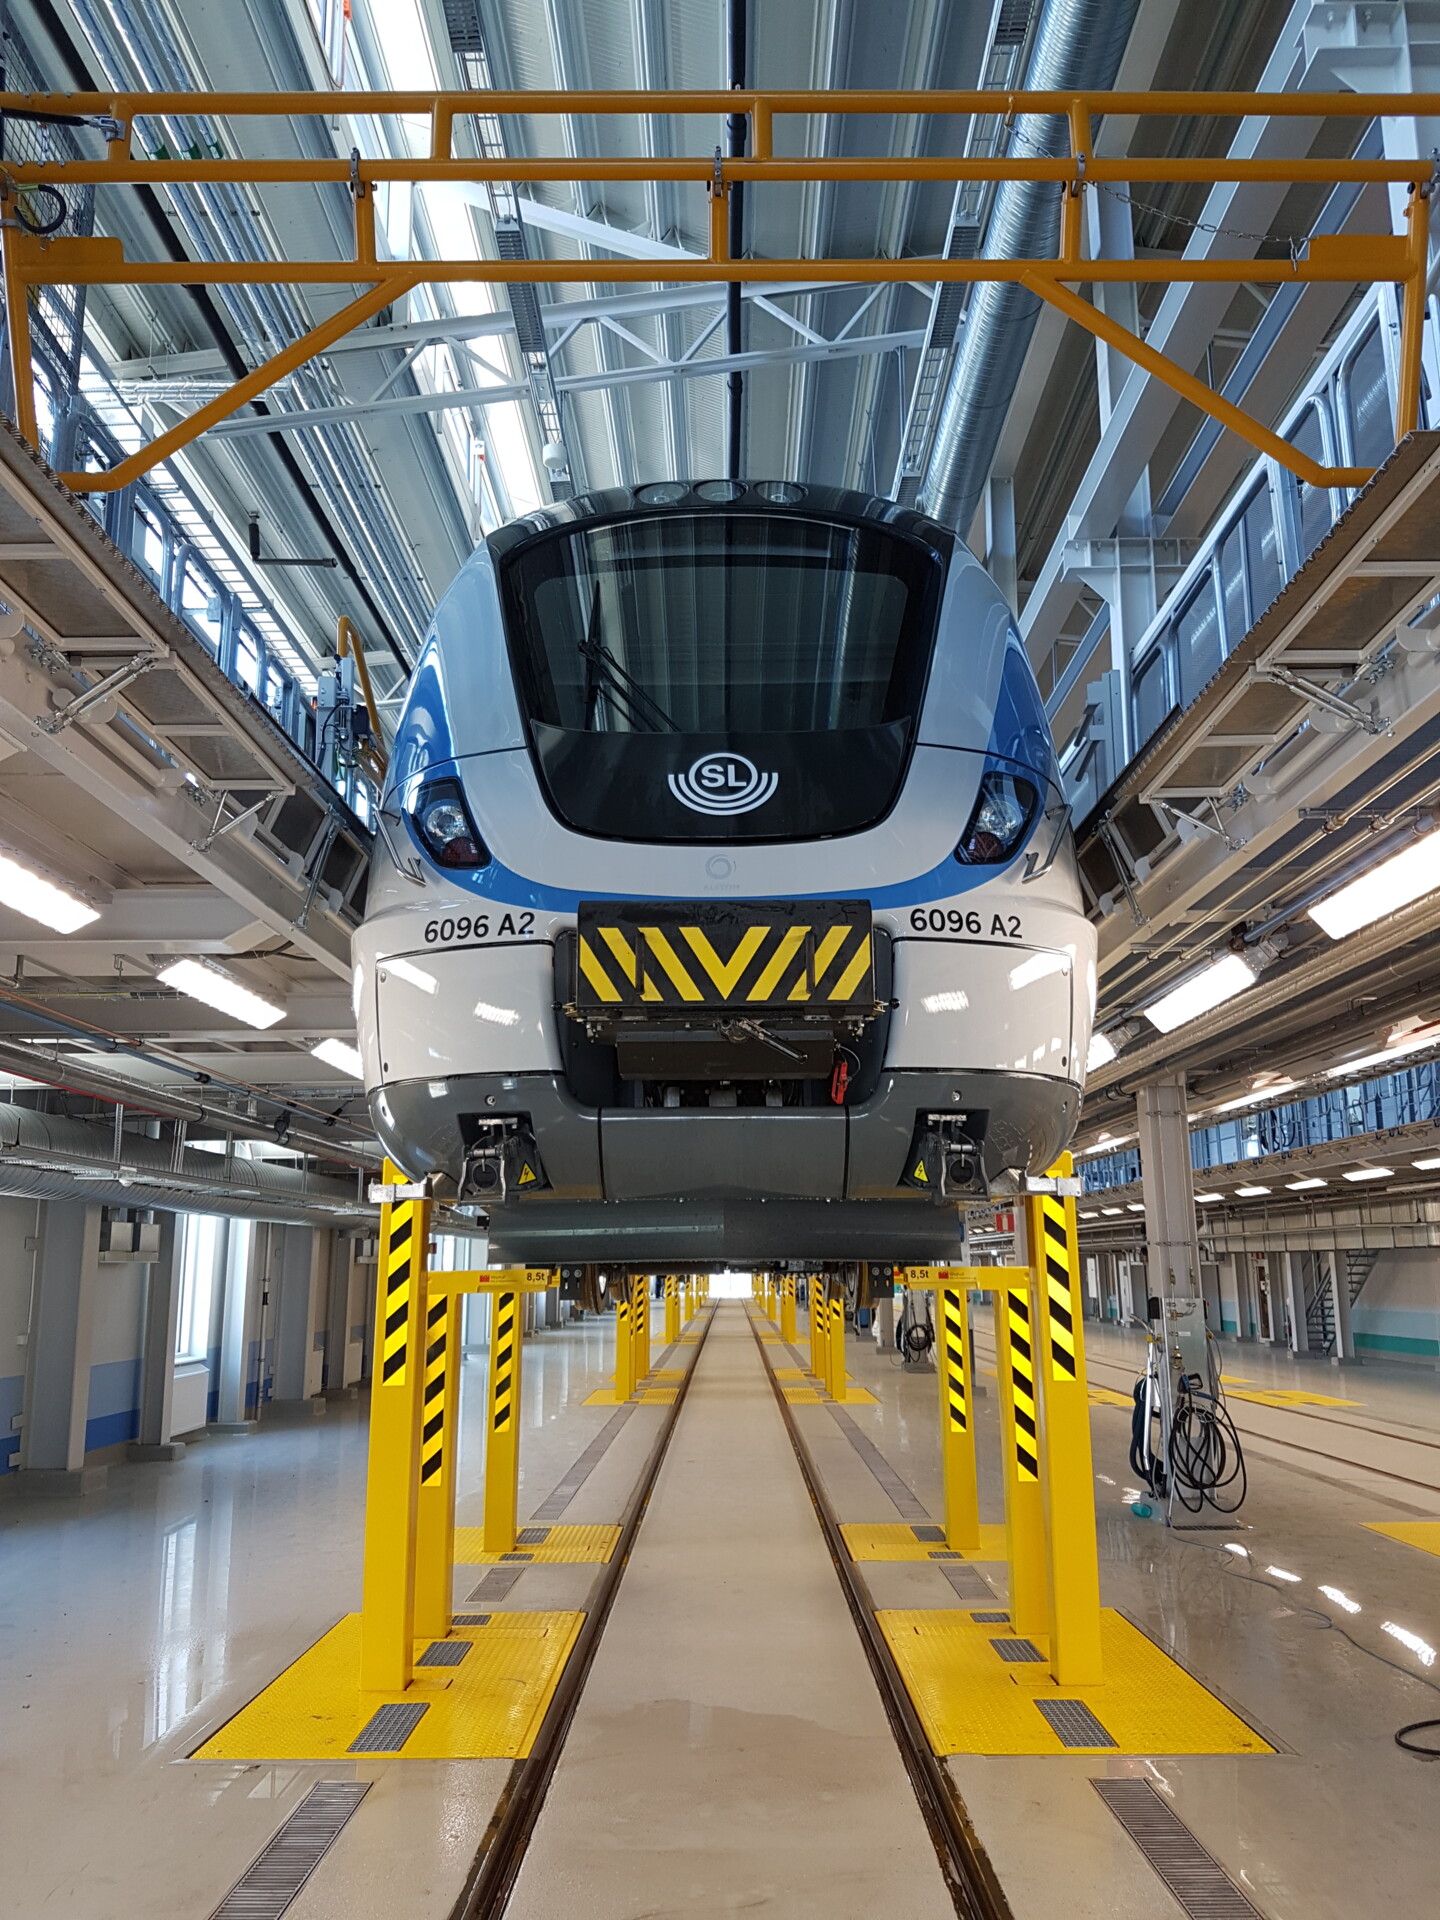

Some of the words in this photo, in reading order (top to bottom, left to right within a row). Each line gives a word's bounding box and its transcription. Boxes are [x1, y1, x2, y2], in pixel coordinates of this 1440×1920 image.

[701, 764, 747, 788] SL
[424, 914, 490, 943] 6096
[497, 911, 536, 937] A2
[910, 908, 982, 935] 6096
[990, 913, 1023, 939] A2
[526, 1272, 545, 1282] 8,5t
[910, 1269, 929, 1280] 8,5t
